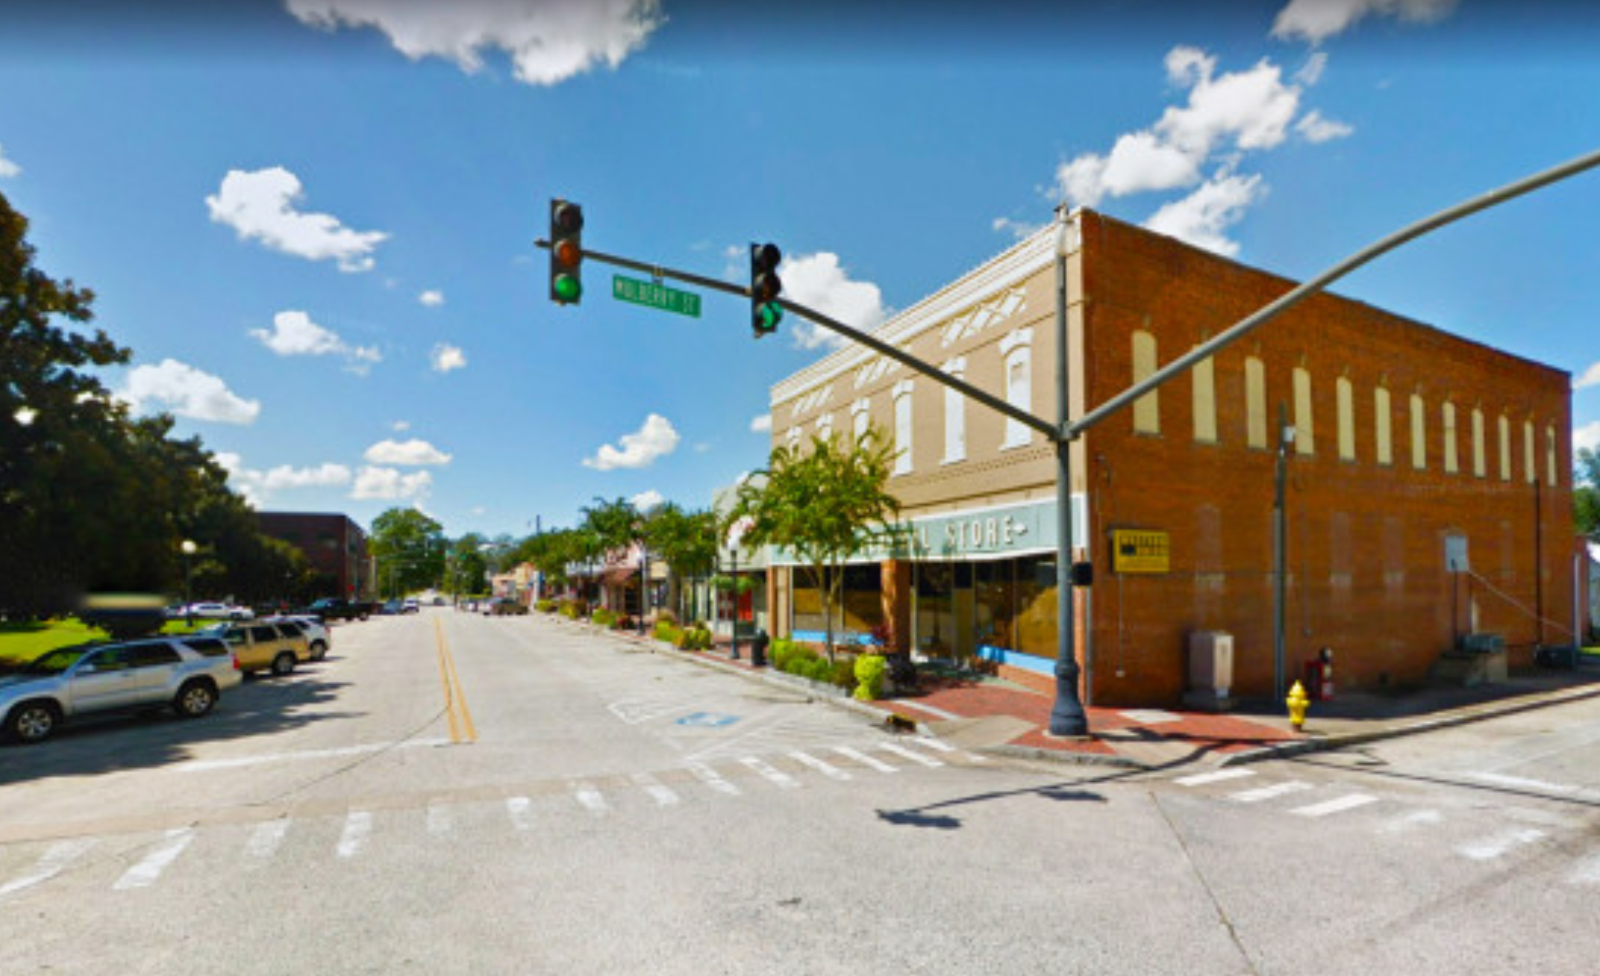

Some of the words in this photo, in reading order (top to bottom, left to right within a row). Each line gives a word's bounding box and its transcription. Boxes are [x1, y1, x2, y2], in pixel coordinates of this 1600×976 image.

[615, 278, 676, 308] MULBERRY
[682, 294, 697, 314] ST
[945, 515, 1013, 548] STORE
